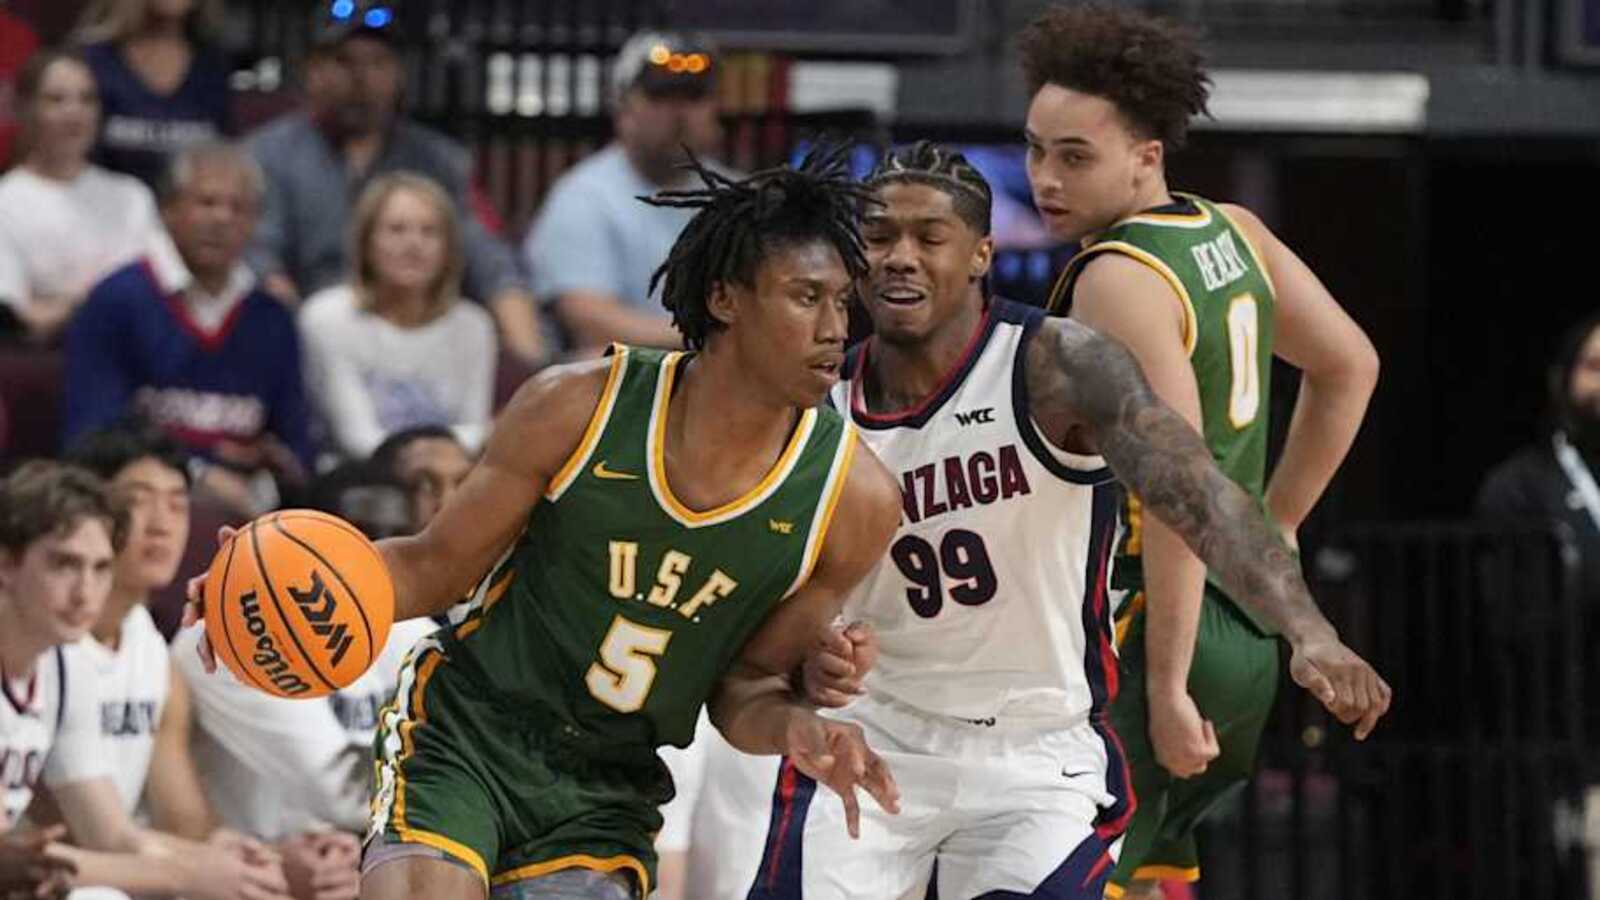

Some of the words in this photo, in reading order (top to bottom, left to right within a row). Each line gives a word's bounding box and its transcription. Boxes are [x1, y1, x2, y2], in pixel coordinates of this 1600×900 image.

[1228, 291, 1260, 430] 0
[955, 407, 996, 427] WCC
[287, 570, 354, 668] WCC
[608, 540, 738, 623] U.S.F.
[891, 528, 997, 618] 99
[240, 589, 311, 693] Wilson
[584, 613, 673, 713] 5
